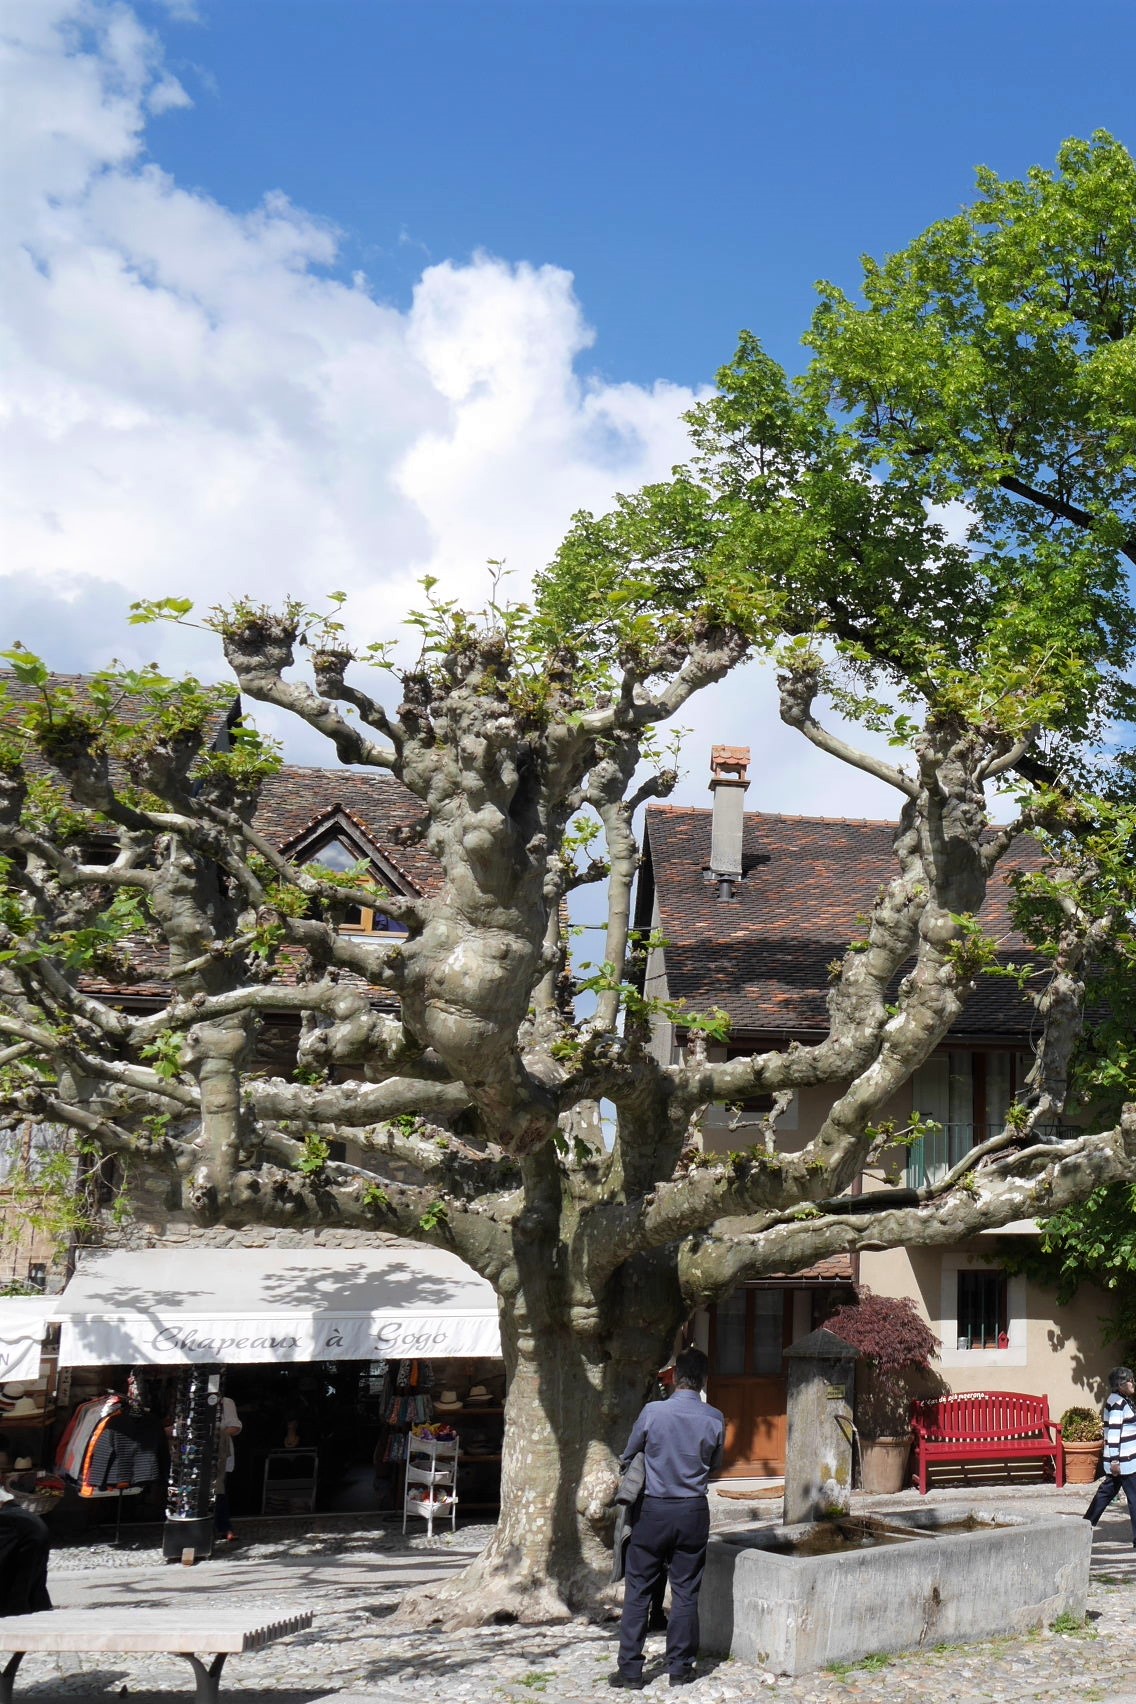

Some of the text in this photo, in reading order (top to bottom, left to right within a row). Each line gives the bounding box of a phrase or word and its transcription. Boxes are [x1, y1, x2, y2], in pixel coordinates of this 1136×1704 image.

[144, 1322, 448, 1356] Chapeaux à Gogo
